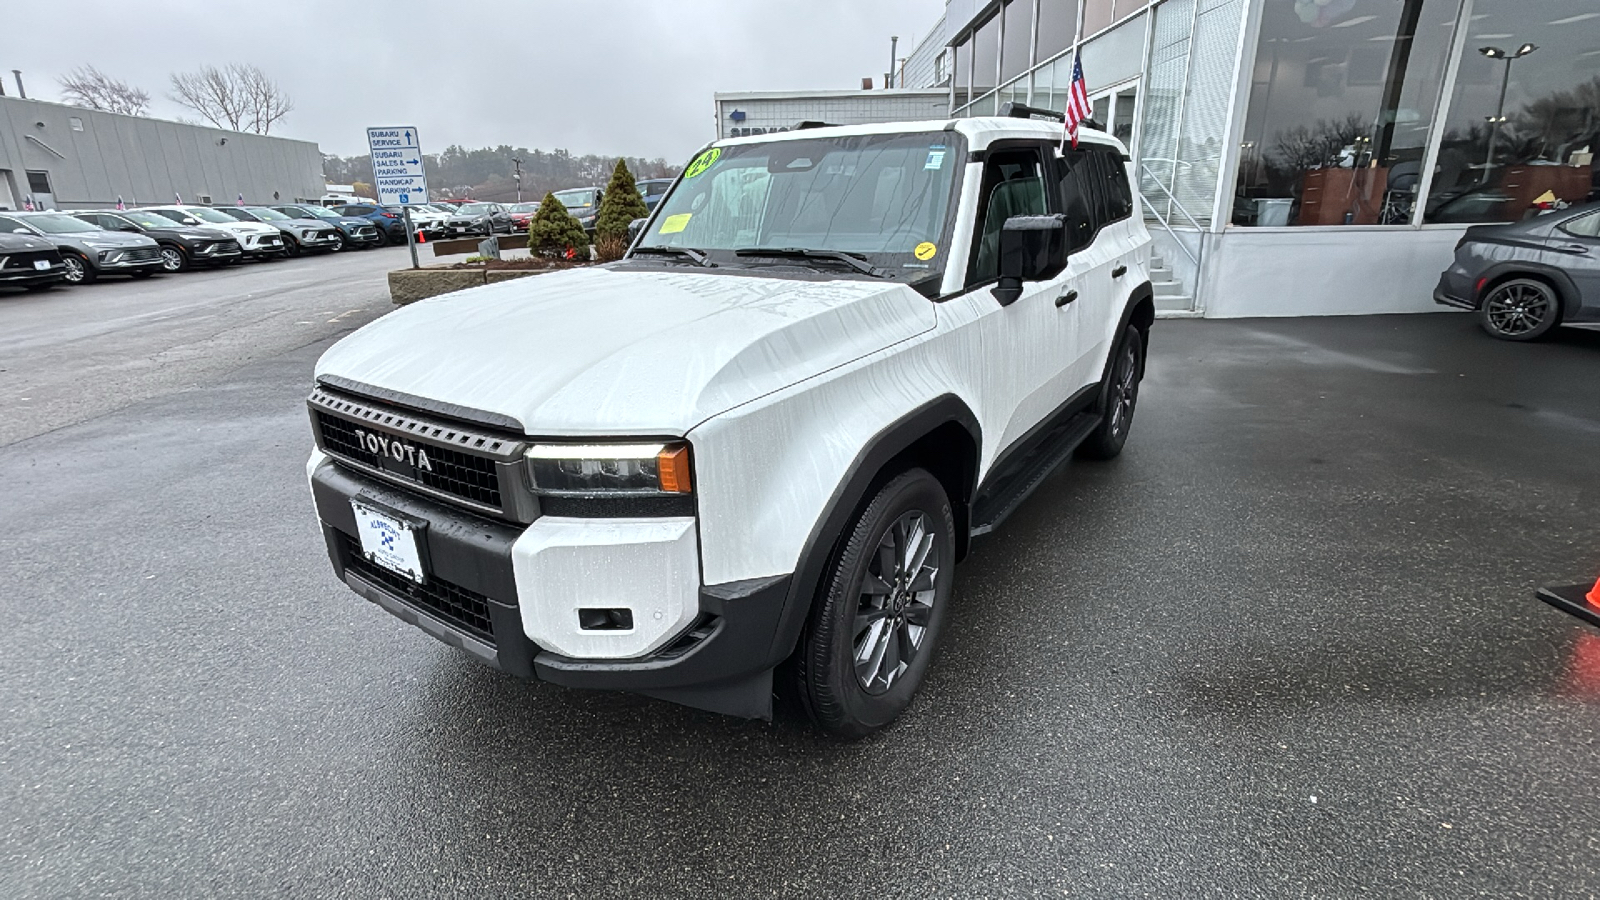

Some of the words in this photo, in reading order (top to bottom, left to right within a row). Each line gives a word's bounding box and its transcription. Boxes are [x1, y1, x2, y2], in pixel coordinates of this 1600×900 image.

[377, 168, 407, 176] PARKING
[379, 178, 414, 186] HANDICAP
[354, 429, 432, 471] TOYOTA
